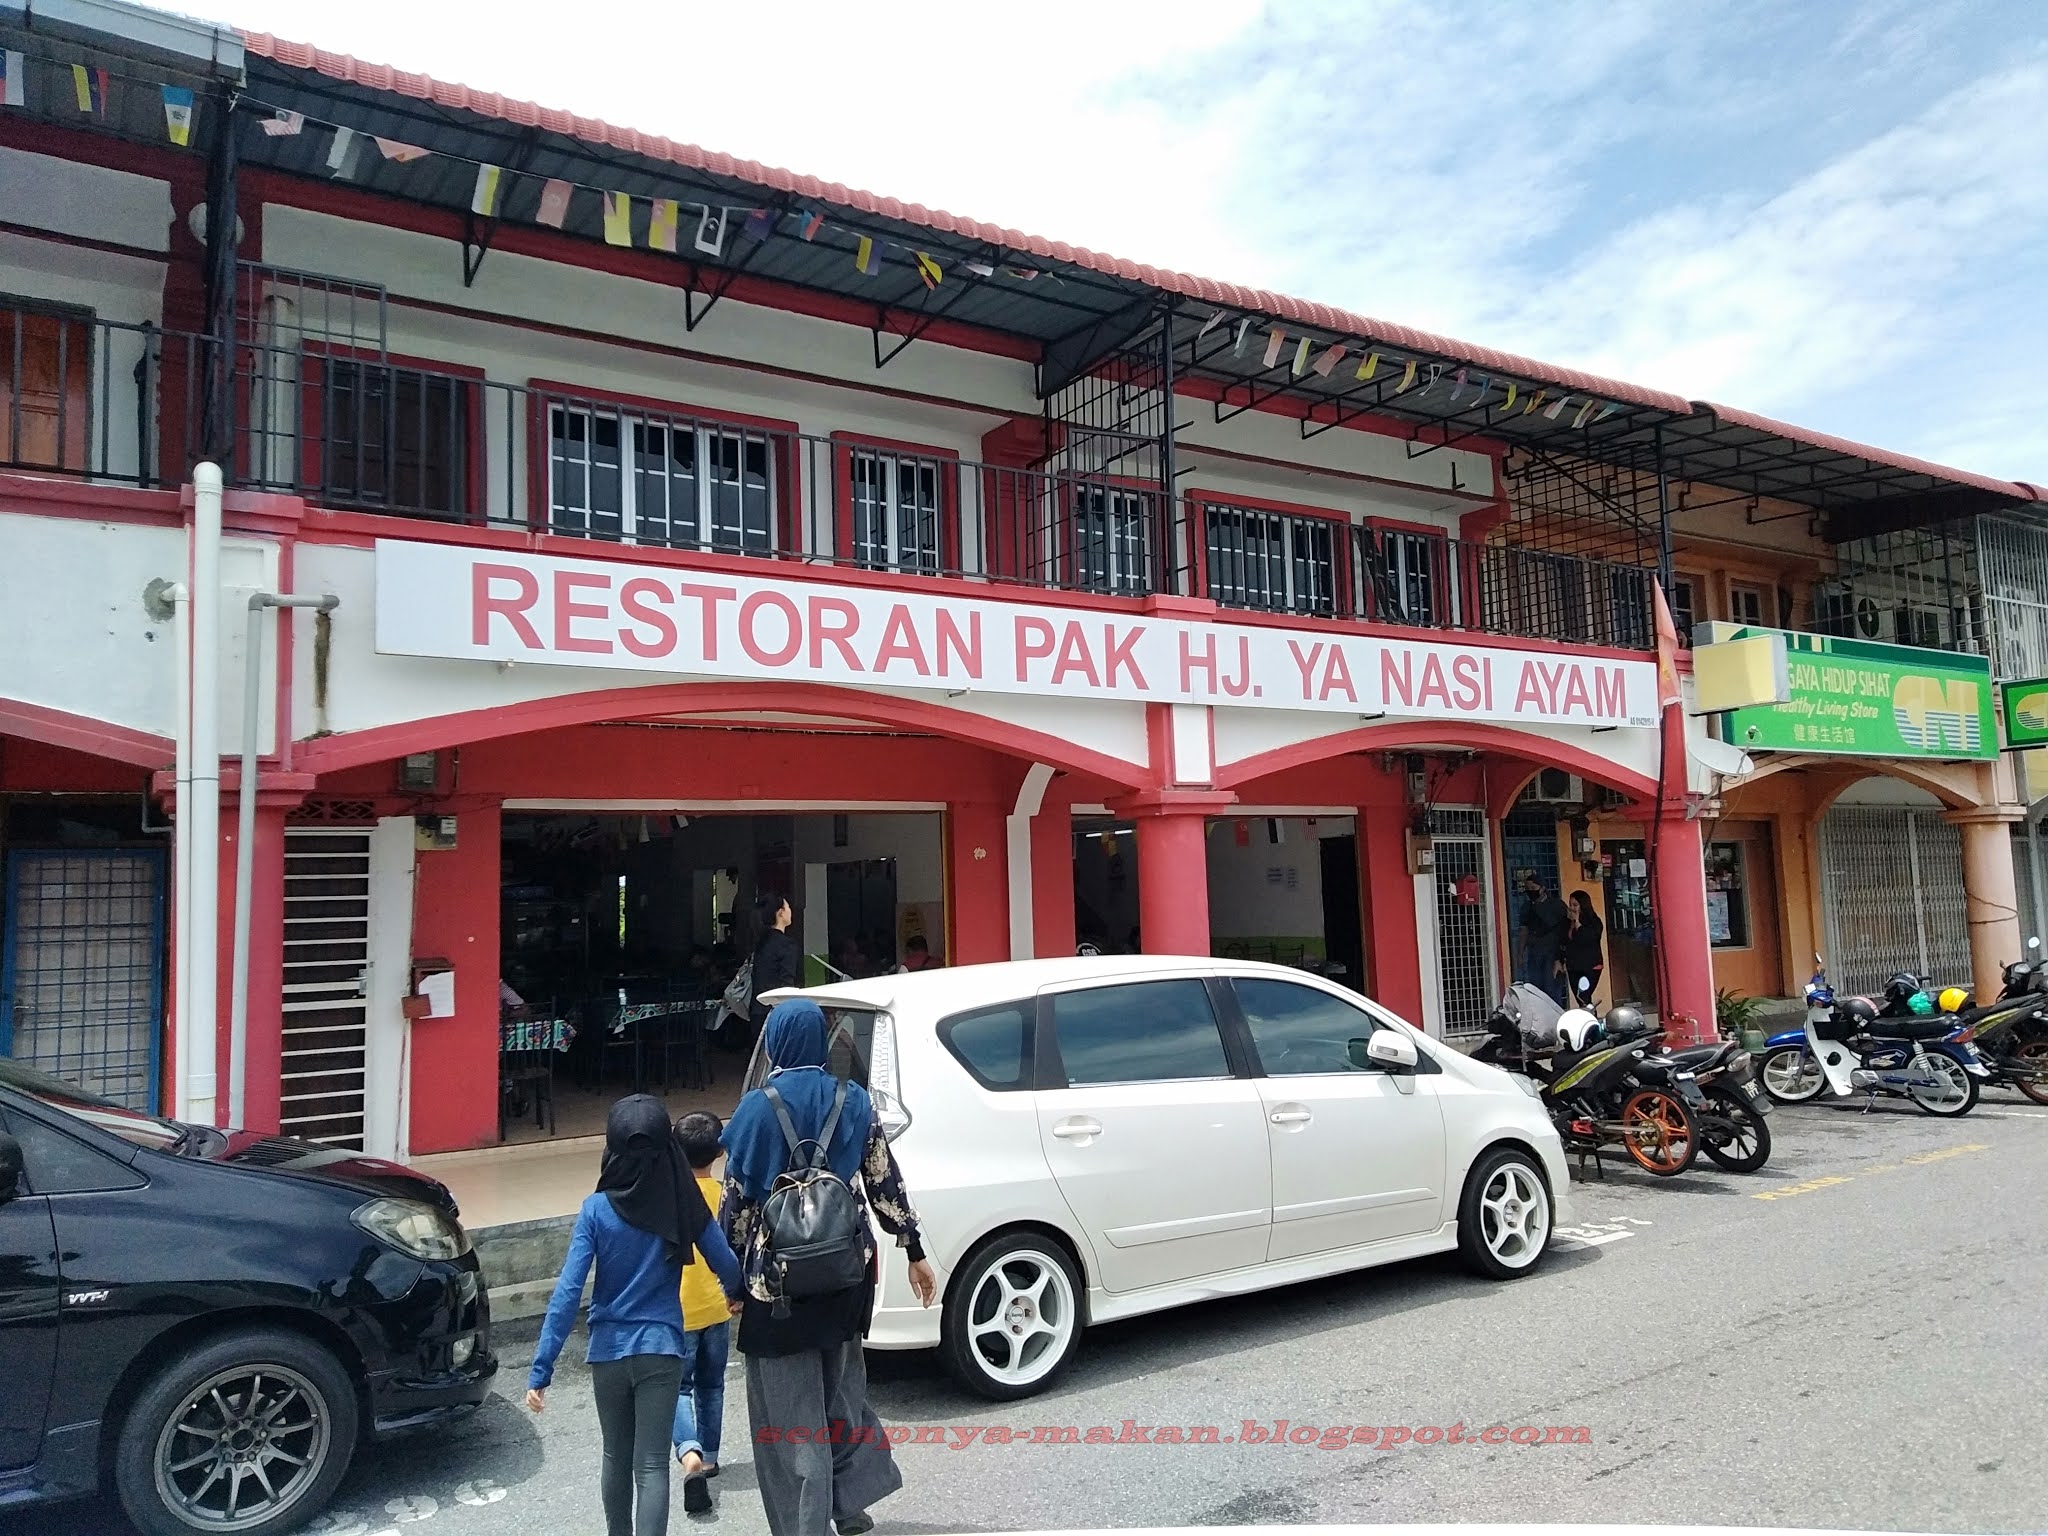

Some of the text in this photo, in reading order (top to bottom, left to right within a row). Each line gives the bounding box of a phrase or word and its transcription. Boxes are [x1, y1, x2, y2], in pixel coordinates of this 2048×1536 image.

[472, 562, 1627, 719] RESTORAN PAK HJ. YA NASI AYAM
[1821, 666, 1857, 695] HIDUP
[1859, 670, 1890, 698] SIHAT
[1816, 698, 1848, 721] Living
[1850, 701, 1879, 719] Store
